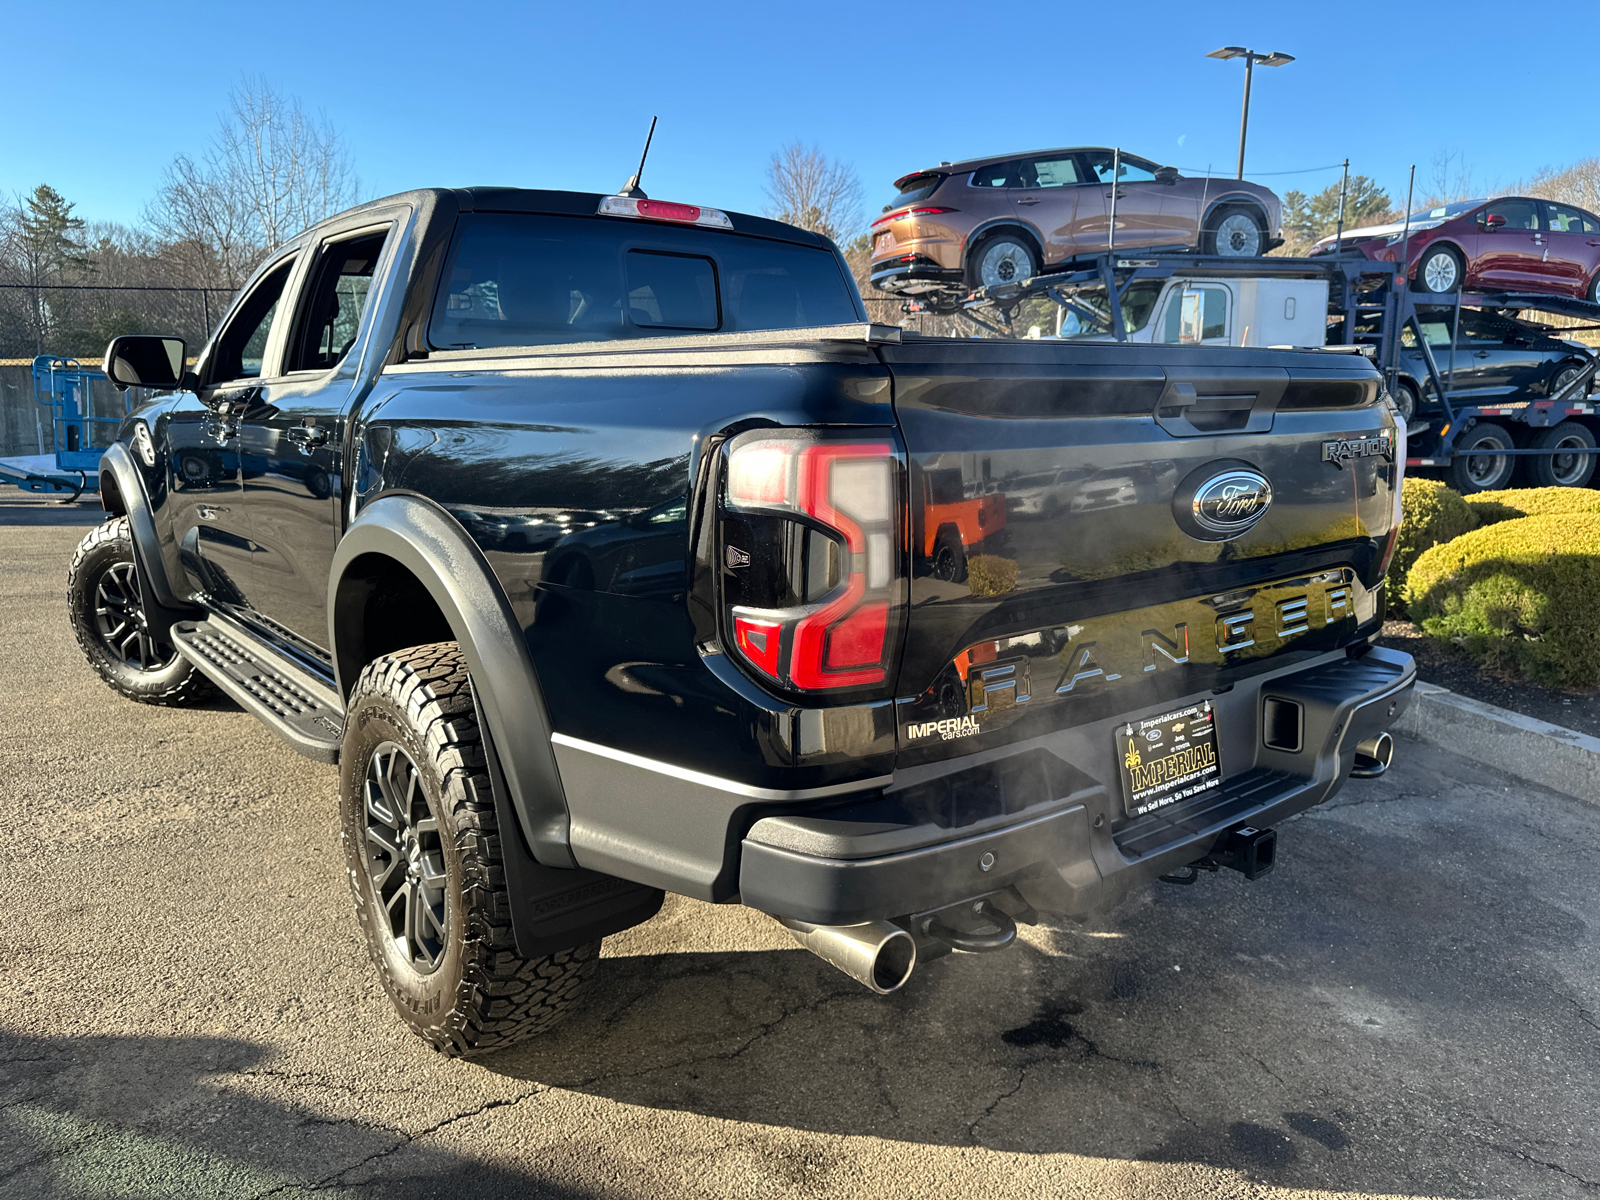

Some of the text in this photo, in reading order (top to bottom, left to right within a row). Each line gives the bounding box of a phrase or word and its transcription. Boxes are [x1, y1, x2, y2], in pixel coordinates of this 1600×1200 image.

[1322, 438, 1391, 470] RAPTOR
[1217, 484, 1259, 517] Ford
[967, 582, 1355, 713] RANGER
[908, 715, 980, 739] IMPERIAL
[941, 727, 980, 741] cars.com
[1140, 707, 1198, 729] Imperialcars.com
[1175, 742, 1191, 751] TOYOTA
[1130, 742, 1216, 792] IMPERIAL
[1133, 765, 1217, 800] www.imperialcars.com
[1138, 779, 1219, 814] We Sell More, So You Save More
